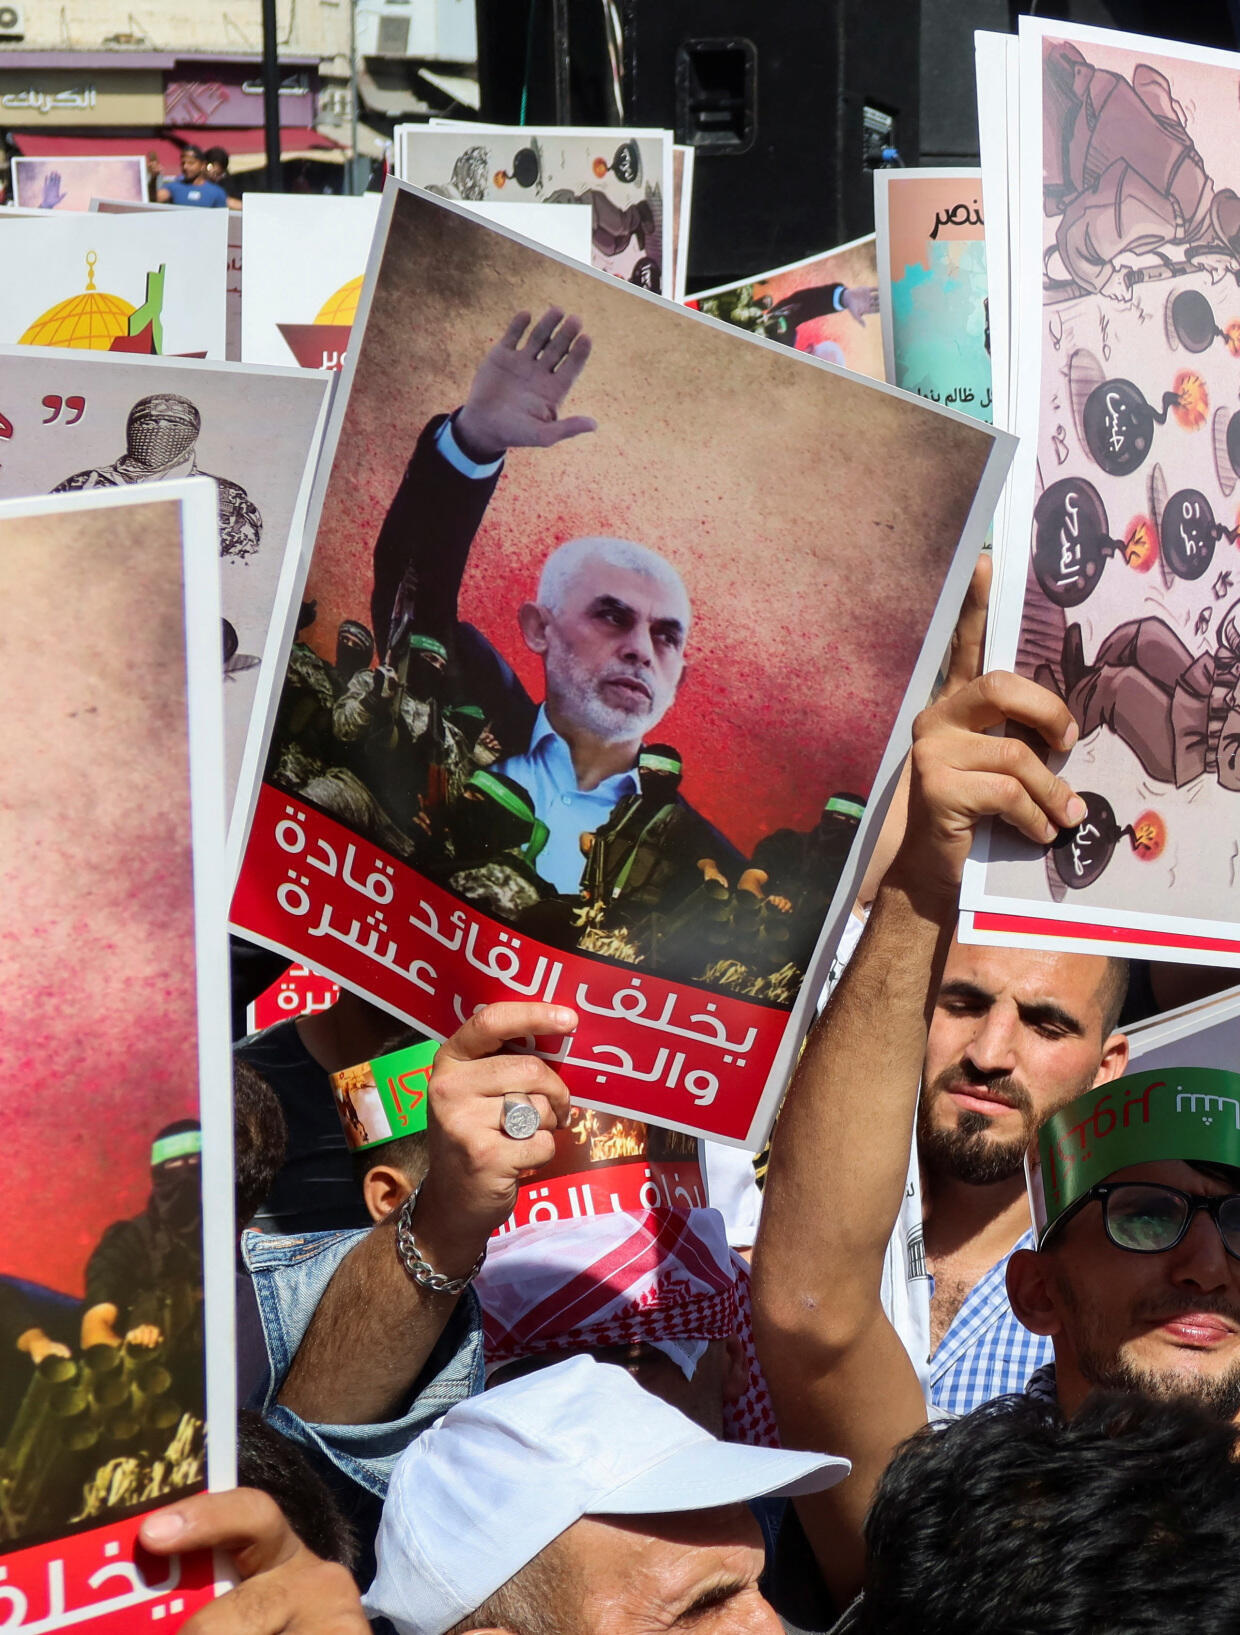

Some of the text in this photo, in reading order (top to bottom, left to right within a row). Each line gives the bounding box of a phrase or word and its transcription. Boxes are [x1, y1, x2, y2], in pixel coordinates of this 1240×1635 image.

[945, 387, 974, 406] ظالم
[1106, 392, 1126, 452] جنين
[274, 804, 758, 1067] يخلف القائد قادة
[276, 868, 438, 995] عشرة
